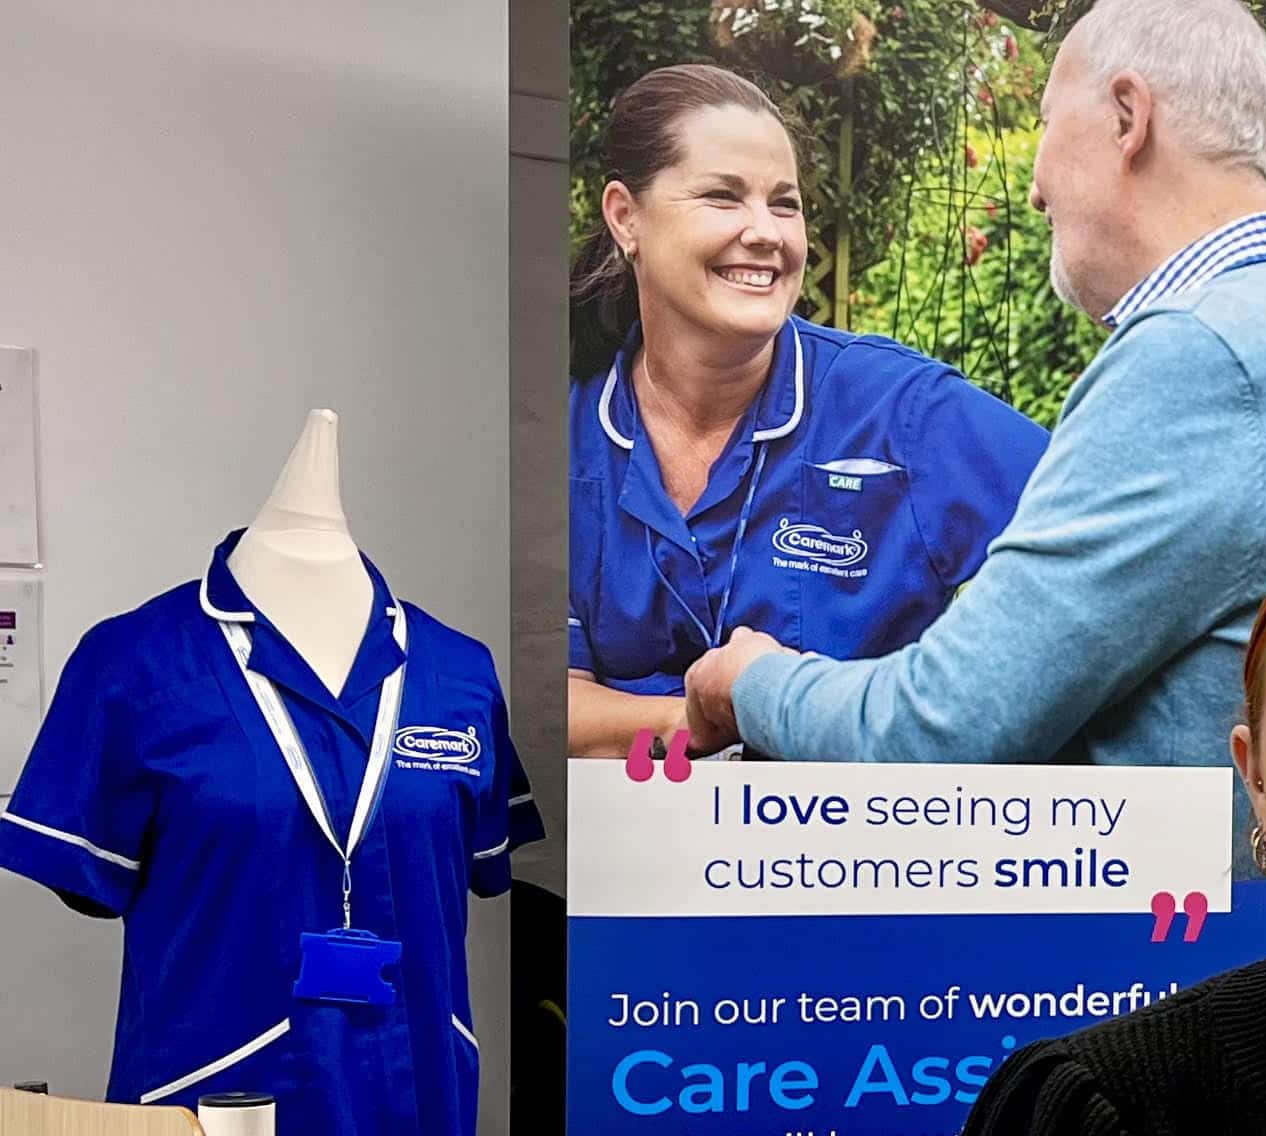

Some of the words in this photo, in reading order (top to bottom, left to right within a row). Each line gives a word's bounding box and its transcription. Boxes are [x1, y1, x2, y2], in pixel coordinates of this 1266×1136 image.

[829, 475, 862, 490] CARE
[403, 735, 470, 754] Caremark
[742, 785, 850, 825] love
[866, 786, 1032, 835] seeing
[1051, 796, 1127, 835] my
[704, 853, 979, 890] customers
[994, 848, 1130, 889] smile
[609, 993, 700, 1028] Join
[714, 998, 786, 1024] our
[798, 990, 906, 1022] team
[919, 986, 960, 1019] of
[612, 1050, 819, 1115] Care
[844, 1035, 1016, 1106] Ass
